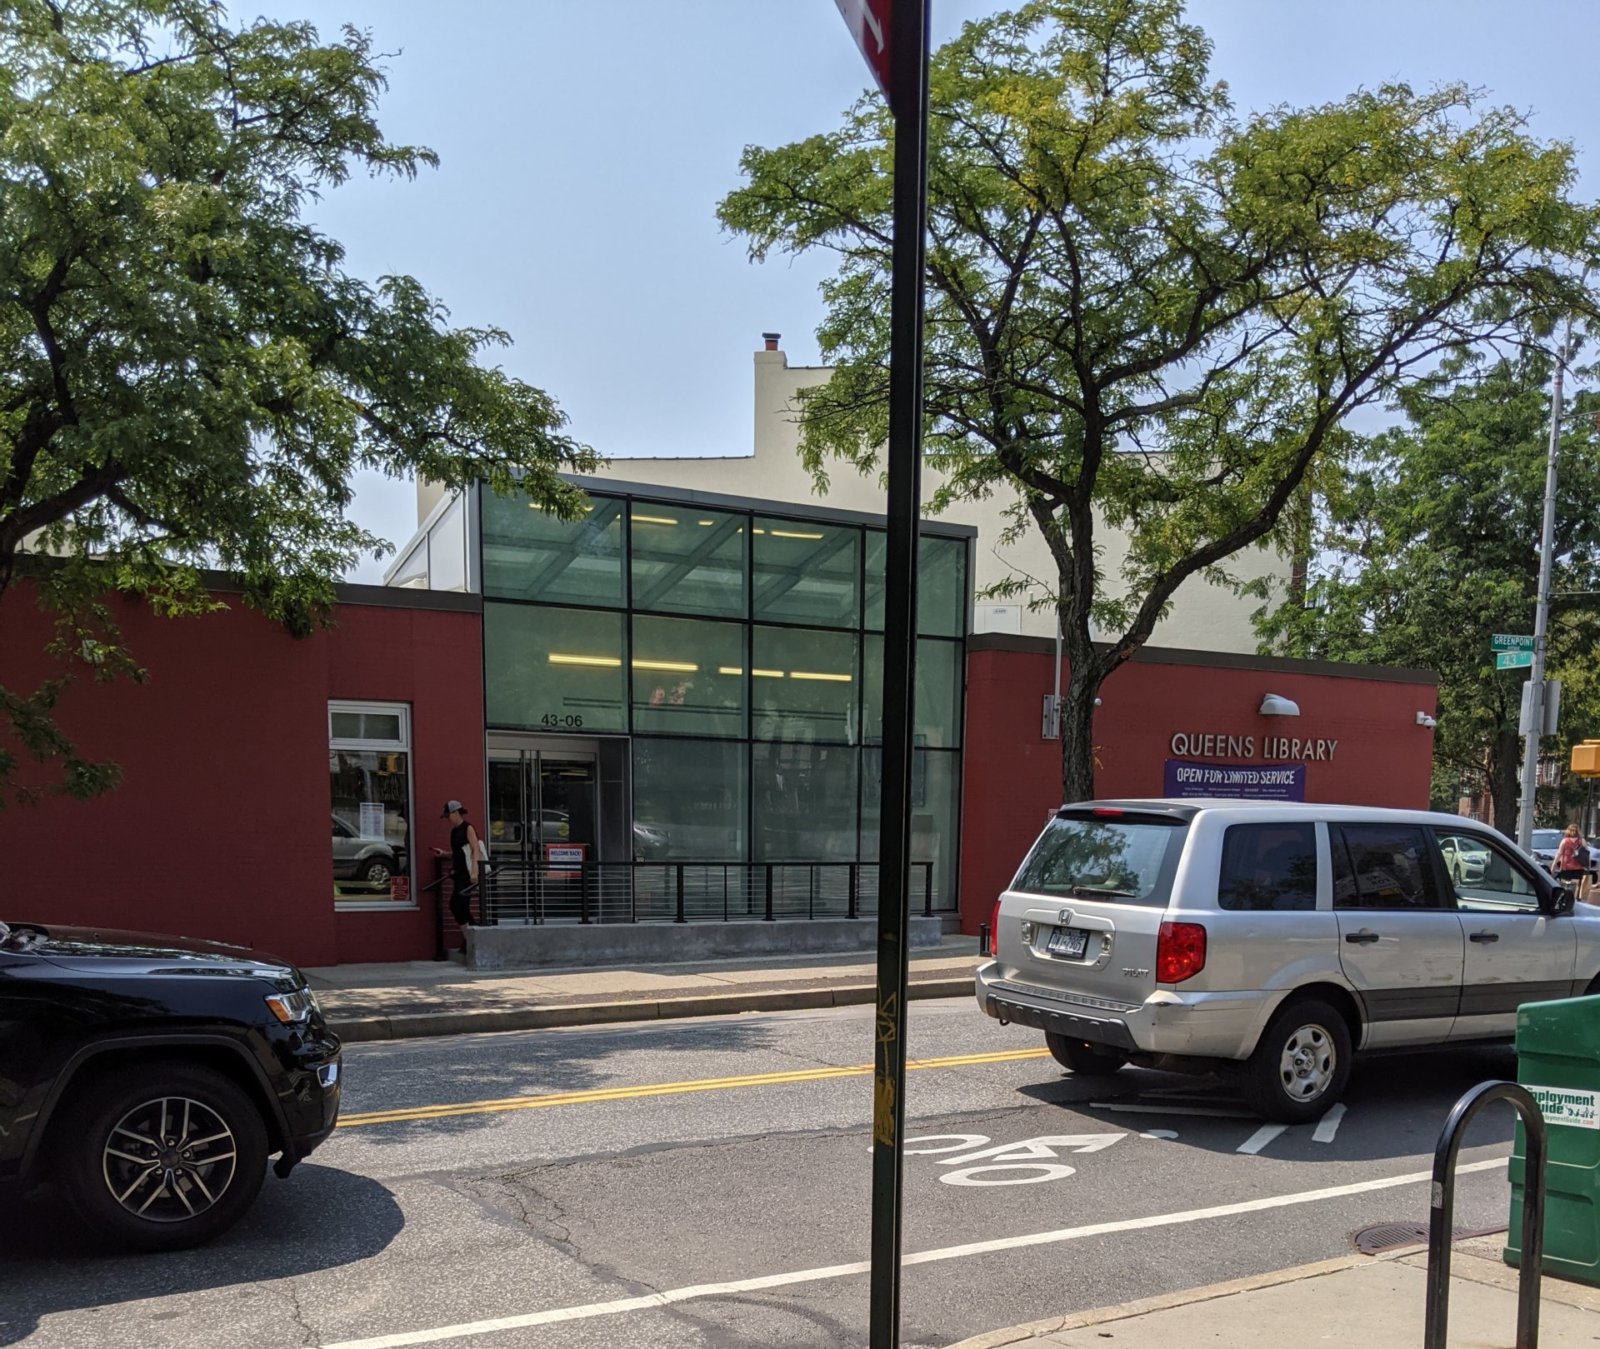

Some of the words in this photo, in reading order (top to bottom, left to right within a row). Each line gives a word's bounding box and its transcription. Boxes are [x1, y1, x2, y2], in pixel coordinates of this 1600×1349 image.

[1494, 636, 1533, 646] GREENPOINT
[1503, 654, 1516, 665] 43
[541, 714, 583, 727] 43-06
[1171, 733, 1254, 758] QUEENS
[1264, 737, 1338, 760] LIBRARY
[1177, 767, 1202, 783] OPEN
[1203, 770, 1222, 783] FOR
[1224, 771, 1260, 784] LIMITED
[1260, 770, 1295, 785] SERVICE
[1532, 1091, 1595, 1106] ployment
[1540, 1102, 1563, 1114] uide
